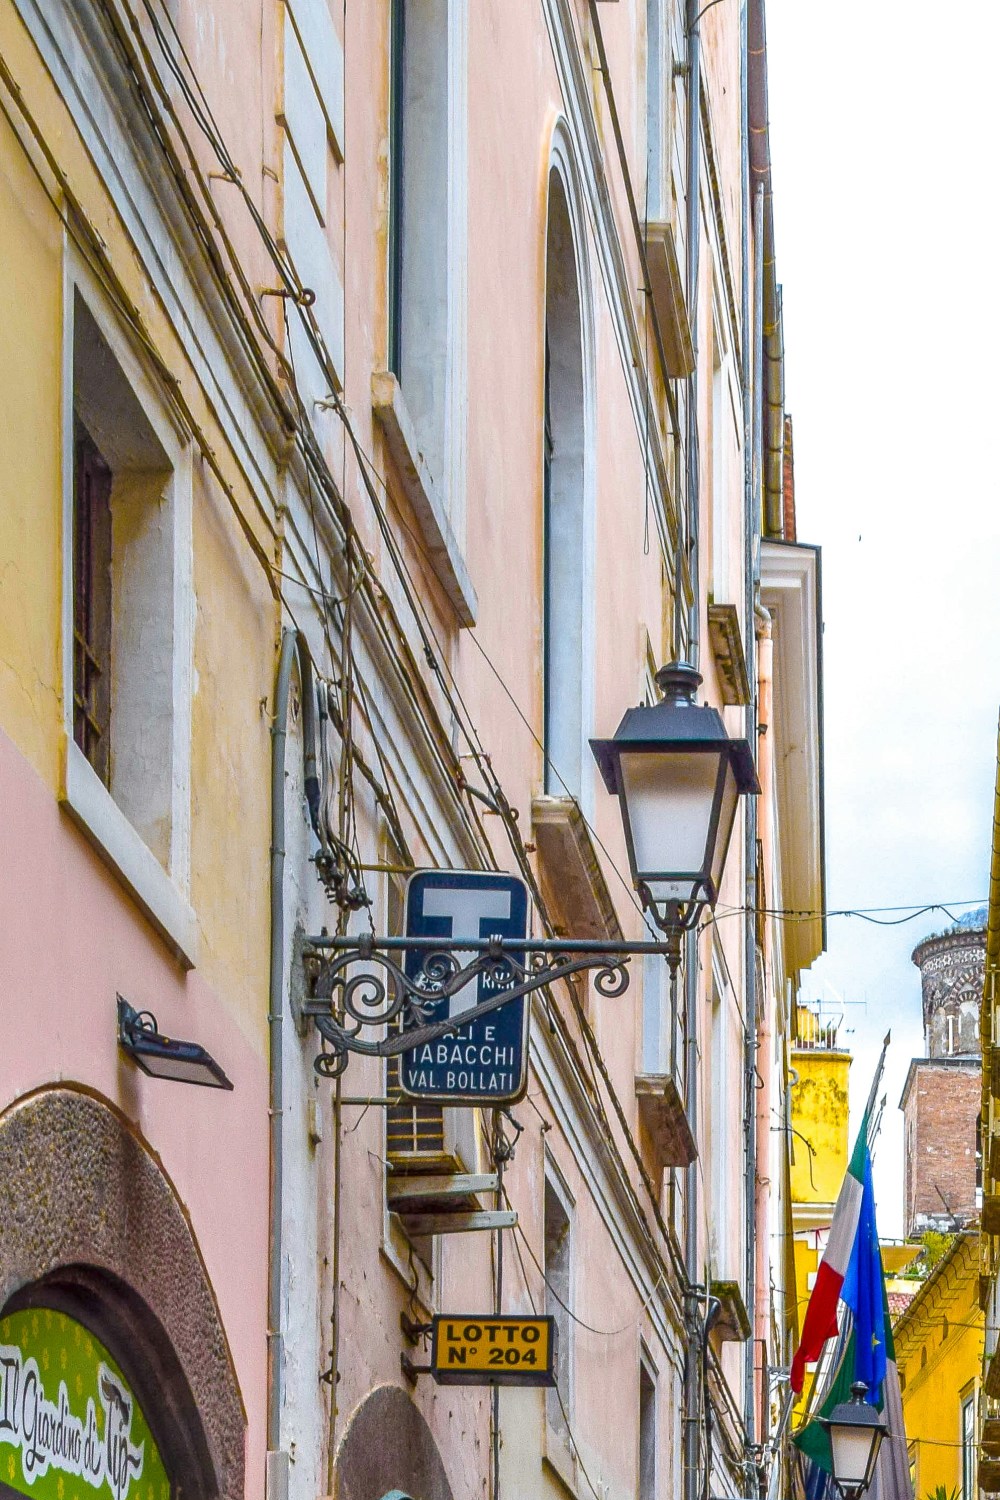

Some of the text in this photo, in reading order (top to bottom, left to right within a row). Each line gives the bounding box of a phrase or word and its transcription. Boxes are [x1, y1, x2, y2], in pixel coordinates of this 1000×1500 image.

[485, 1026, 496, 1041] E
[412, 1043, 514, 1066] TABACCHI
[408, 1069, 513, 1091] VAL. BOLLATI
[446, 1324, 541, 1343] LOTTO
[488, 1347, 538, 1365] 204
[22, 1370, 82, 1472] Giardino
[84, 1408, 101, 1476] di
